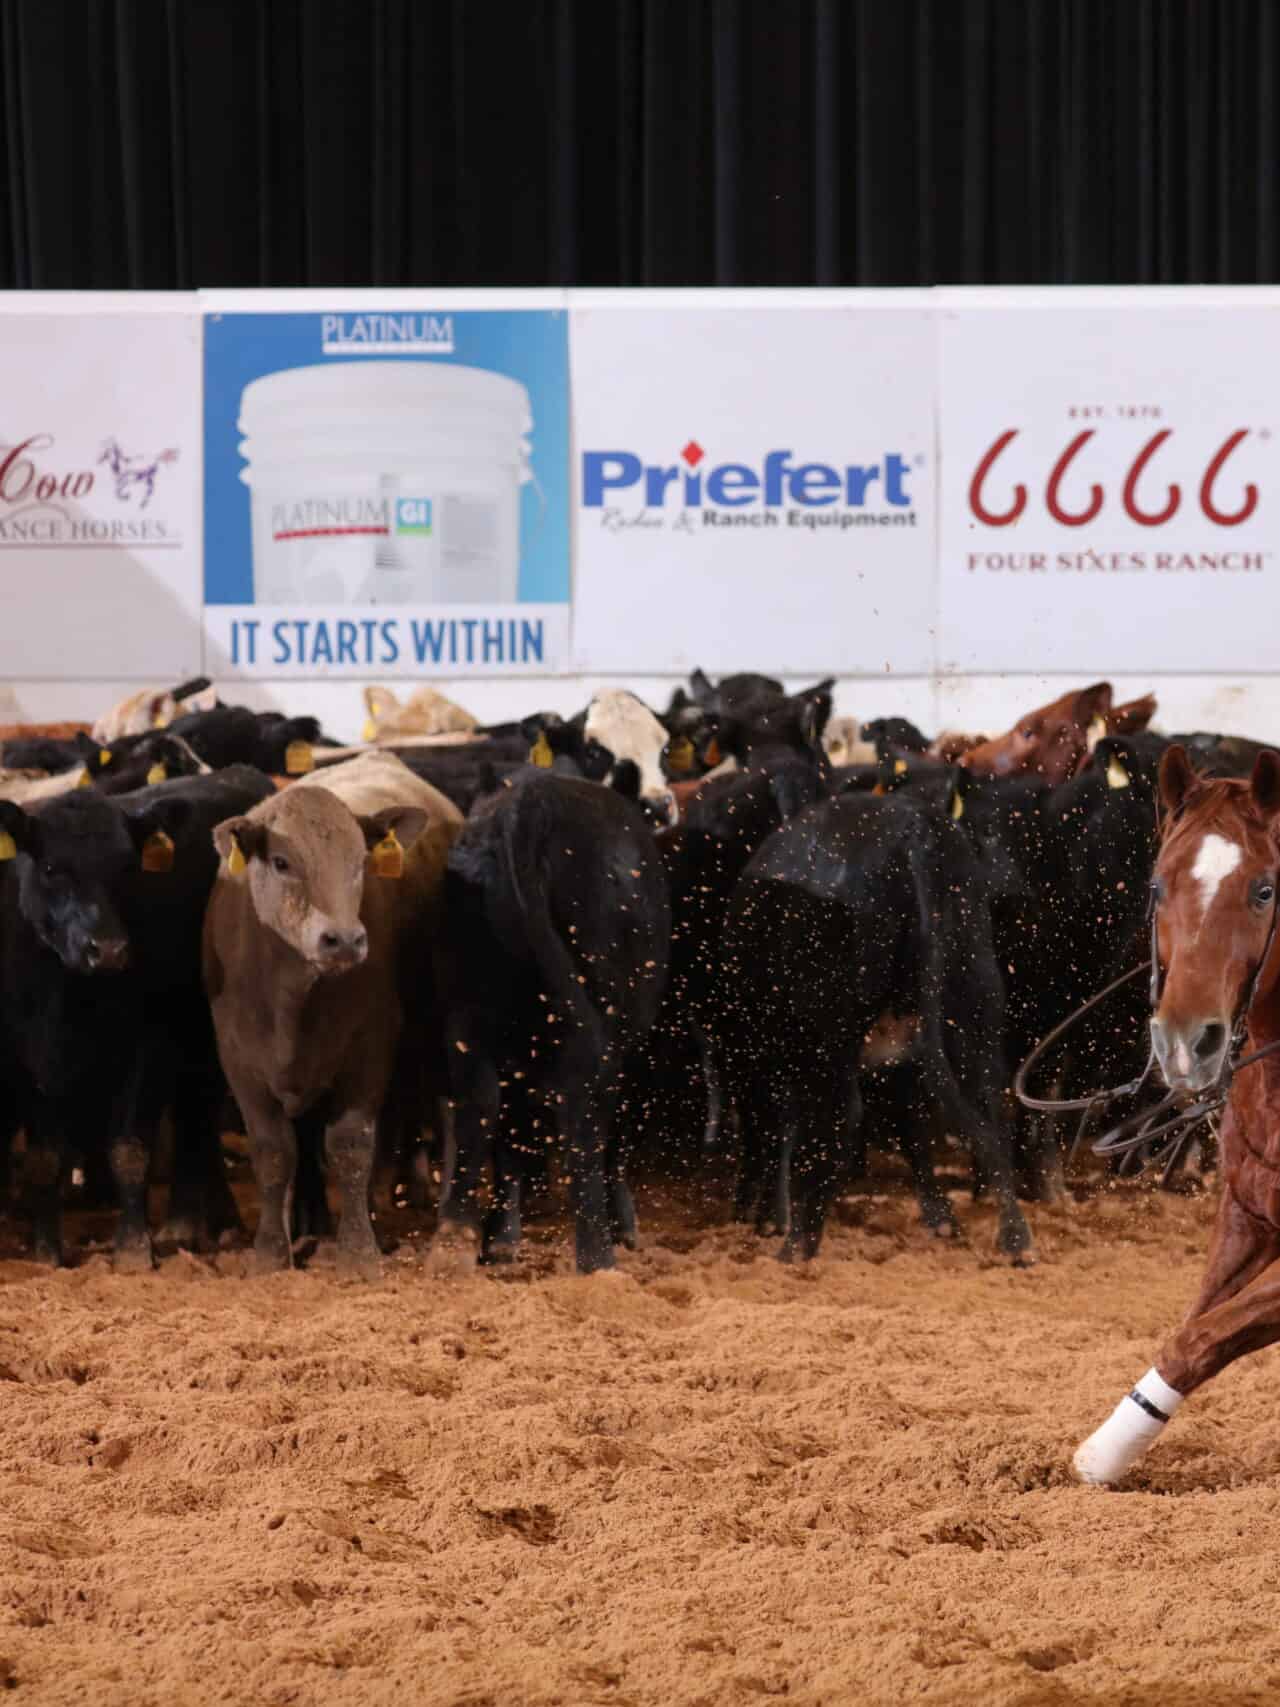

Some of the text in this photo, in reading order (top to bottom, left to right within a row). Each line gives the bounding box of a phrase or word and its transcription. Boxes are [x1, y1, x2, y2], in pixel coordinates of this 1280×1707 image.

[321, 315, 454, 342] PLATINUM
[0, 433, 95, 502] Cow
[581, 440, 912, 507] Priefert
[968, 428, 1260, 527] 6666
[400, 502, 428, 526] GI
[703, 510, 777, 528] Ranch
[786, 511, 917, 530] Equipment
[71, 519, 168, 538] HORSES
[967, 551, 1264, 572] FOUR SIXES RANCH
[231, 619, 544, 665] IT STARTS WITHIN
